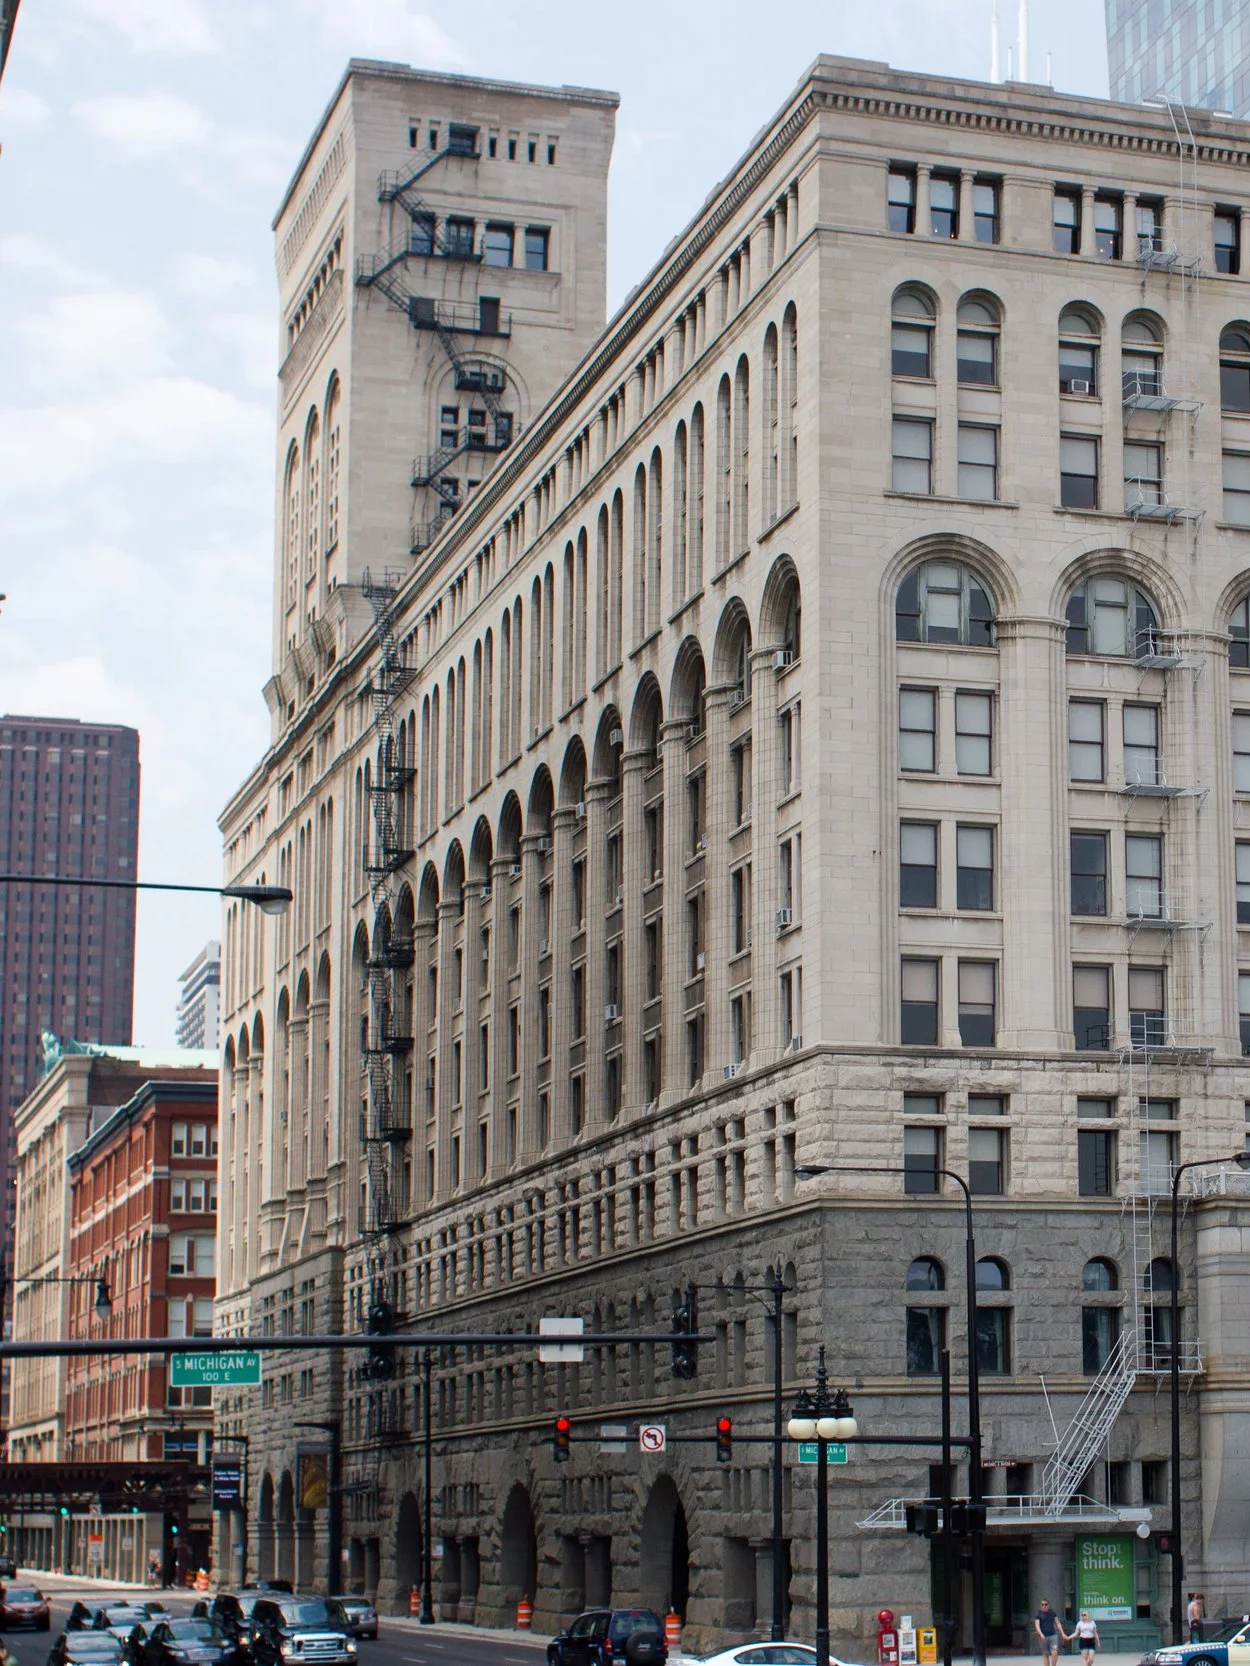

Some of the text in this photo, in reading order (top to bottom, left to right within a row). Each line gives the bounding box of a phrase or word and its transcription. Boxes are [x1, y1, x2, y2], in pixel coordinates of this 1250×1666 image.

[176, 1361, 181, 1369] S
[184, 1357, 244, 1370] MICHIGAN
[202, 1372, 230, 1381] 100 E
[1083, 1555, 1124, 1569] think.
[1083, 1595, 1109, 1605] think
